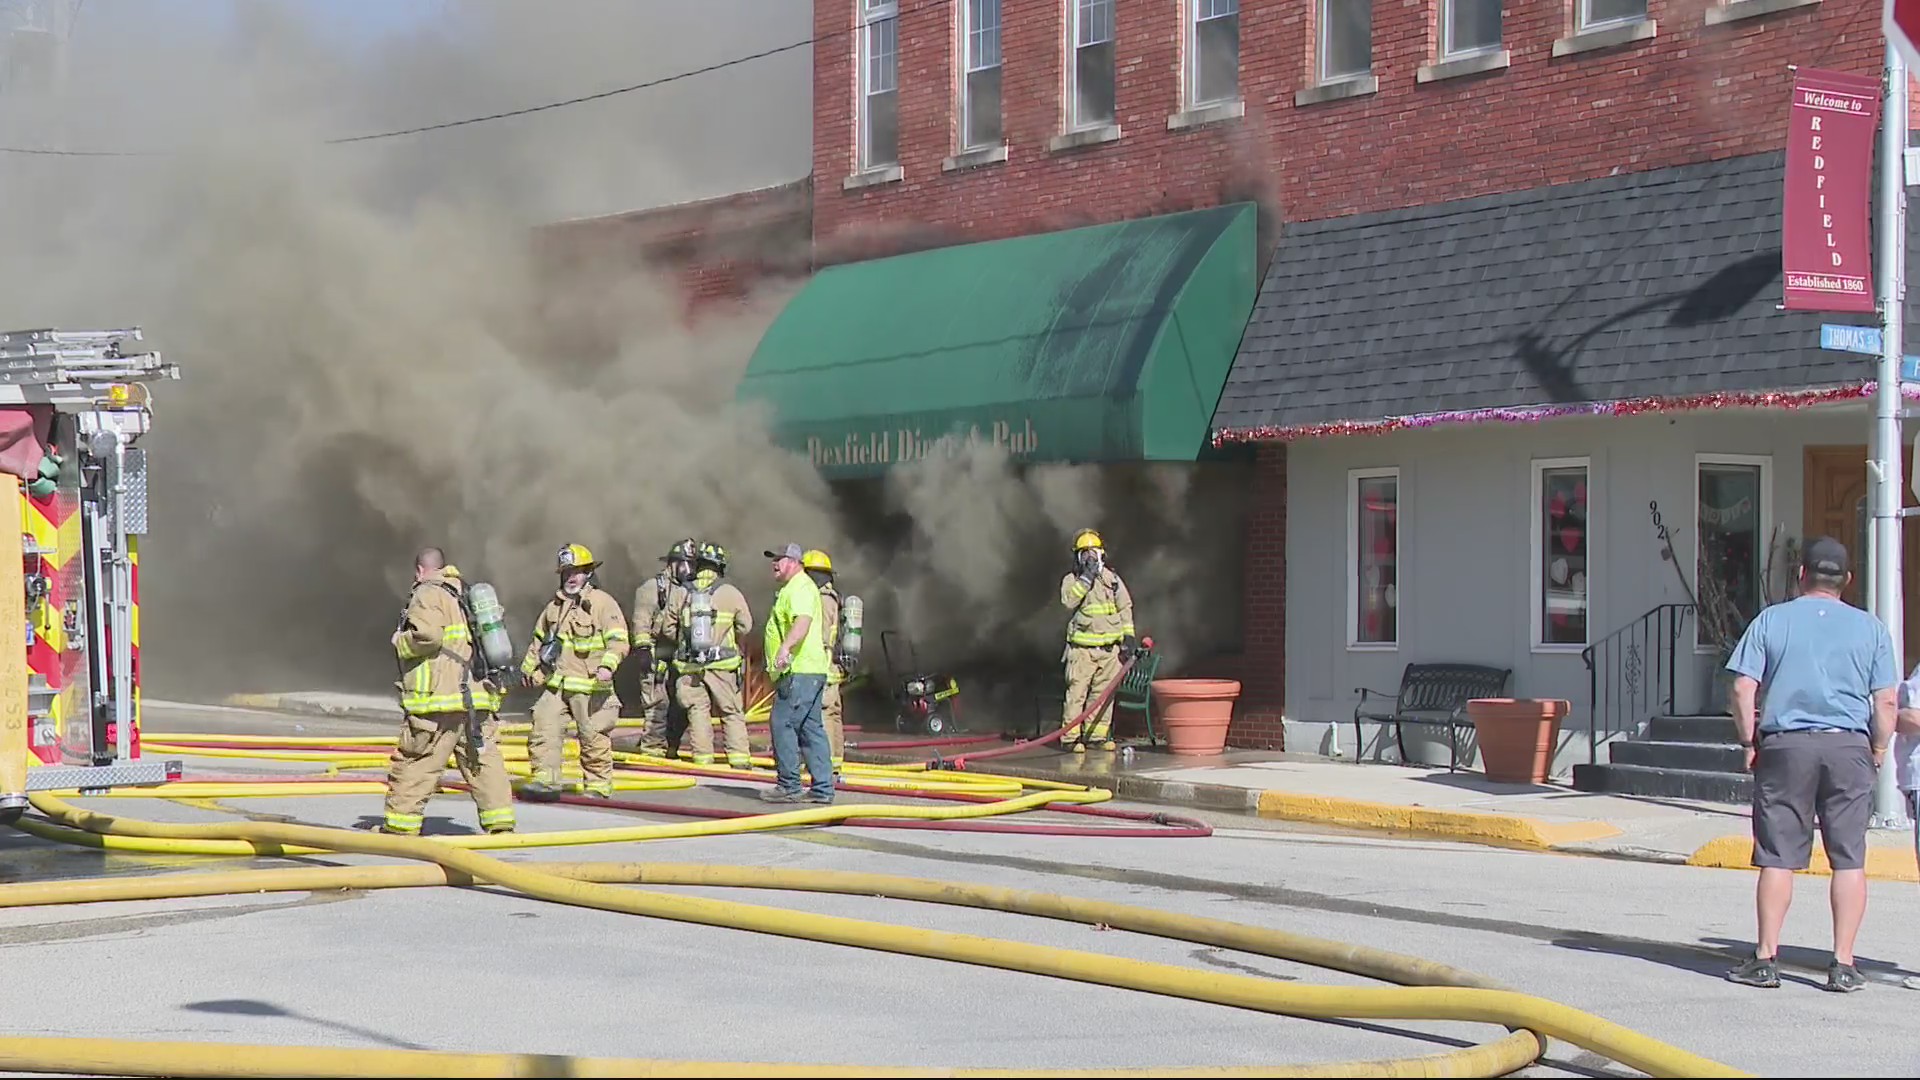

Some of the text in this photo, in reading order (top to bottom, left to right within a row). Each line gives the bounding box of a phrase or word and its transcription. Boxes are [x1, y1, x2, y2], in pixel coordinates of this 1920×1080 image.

[1804, 92, 1862, 111] Welcome to
[1810, 116, 1842, 266] REDFIELD
[1788, 275, 1864, 291] Established 1860
[1829, 328, 1865, 348] THOMAS
[807, 430, 889, 465] Dexfield
[993, 417, 1038, 455] Pub
[1649, 500, 1665, 540] 902
